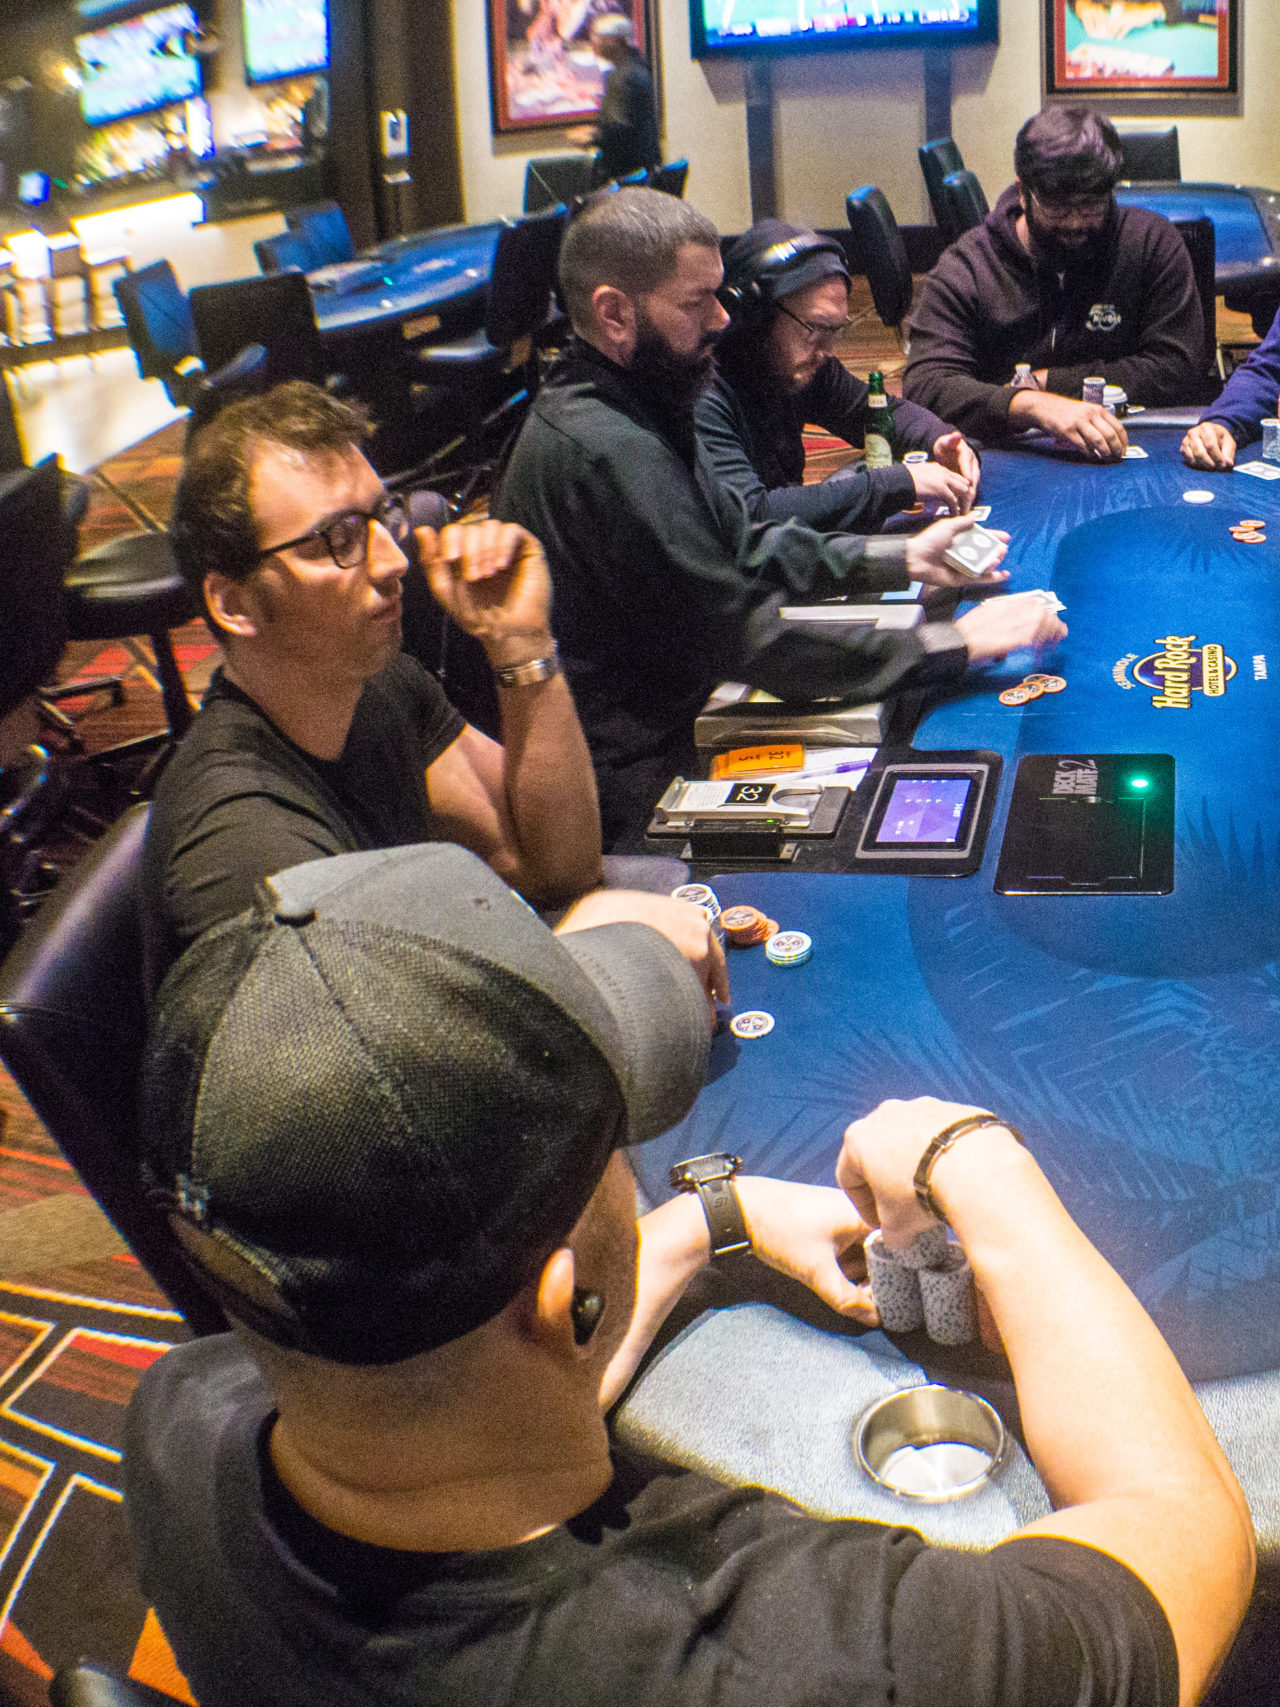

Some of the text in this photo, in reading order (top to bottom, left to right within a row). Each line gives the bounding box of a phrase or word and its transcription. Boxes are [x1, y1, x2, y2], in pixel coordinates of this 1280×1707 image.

[1208, 646, 1219, 668] CASINO
[1253, 655, 1267, 680] TAMPA
[1112, 653, 1139, 690] SEMINOLE
[1152, 635, 1198, 708] Hard Rock
[1209, 675, 1219, 694] HOTEL
[736, 786, 763, 801] 32
[1052, 771, 1076, 794] DECK
[1075, 769, 1098, 794] MATE
